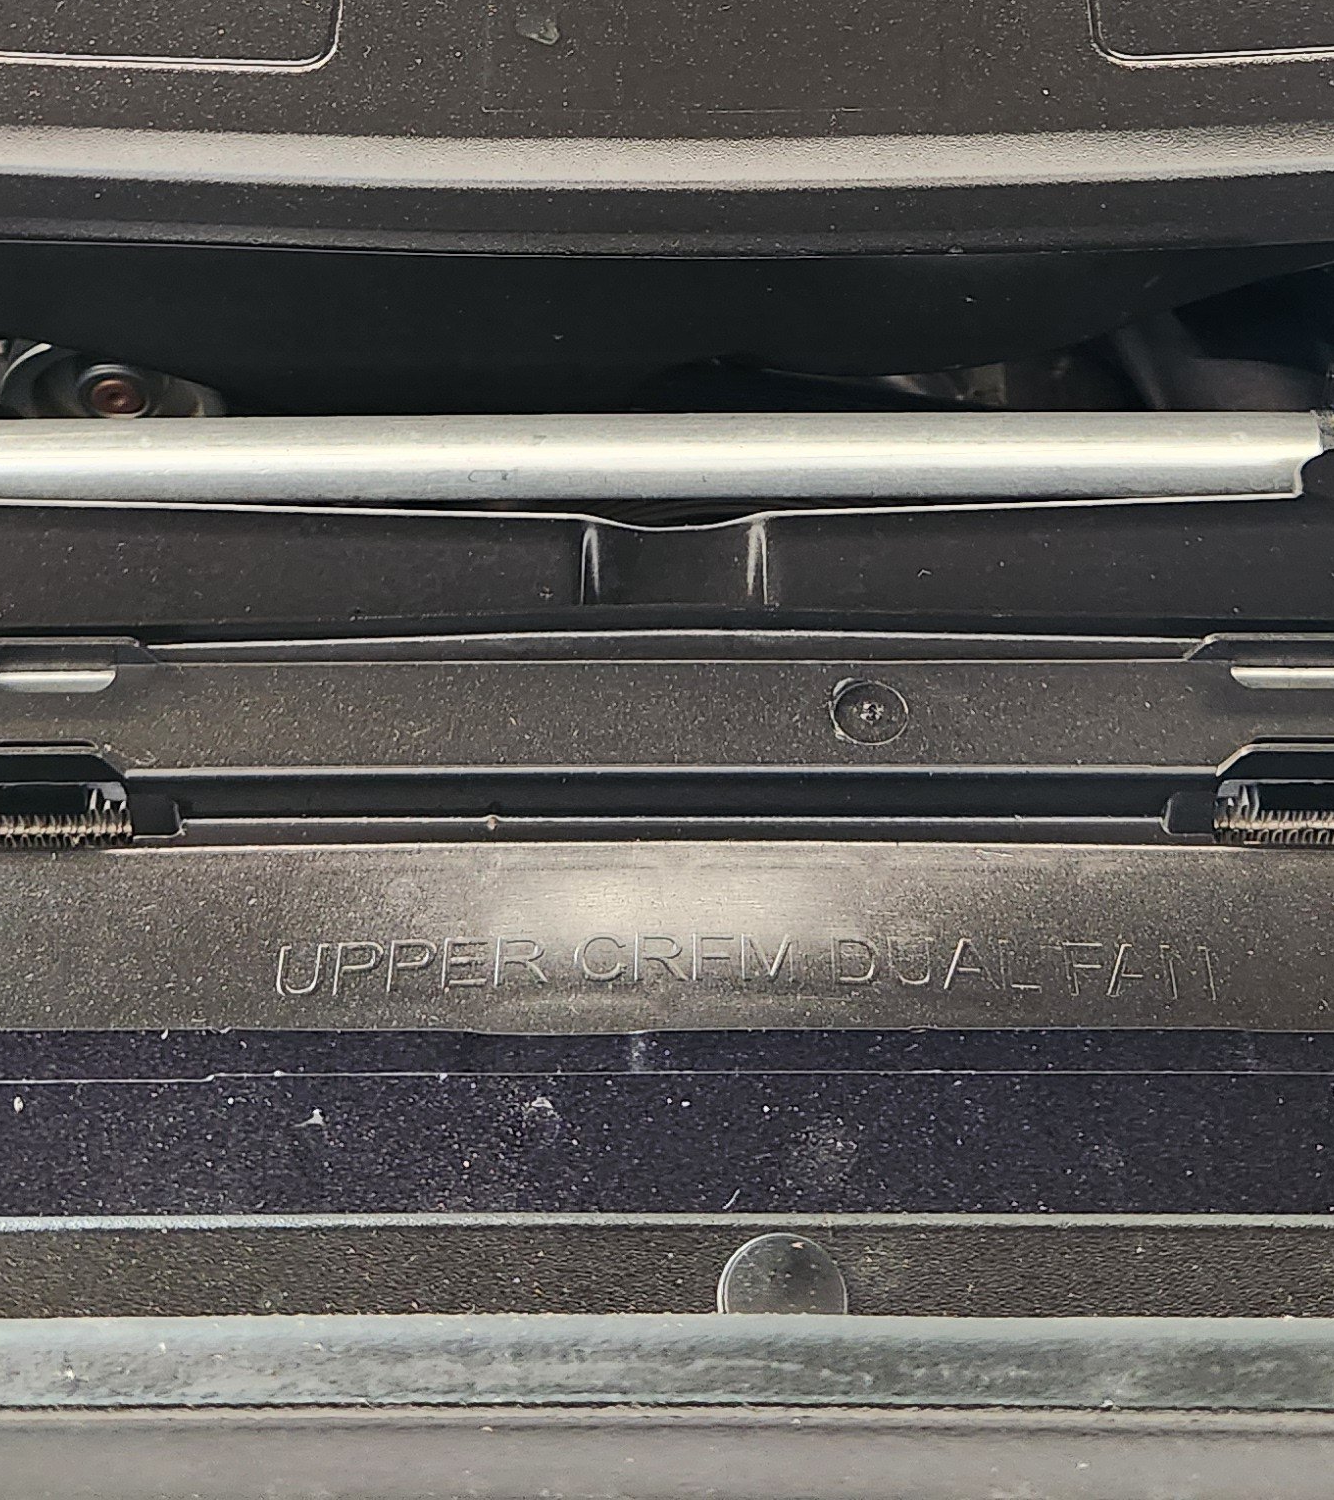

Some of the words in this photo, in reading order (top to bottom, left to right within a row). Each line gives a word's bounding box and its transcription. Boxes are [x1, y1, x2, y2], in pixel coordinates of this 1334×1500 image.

[274, 936, 549, 997] UPPER
[829, 933, 1044, 993] DUAL
[1062, 940, 1219, 1001] FAN
